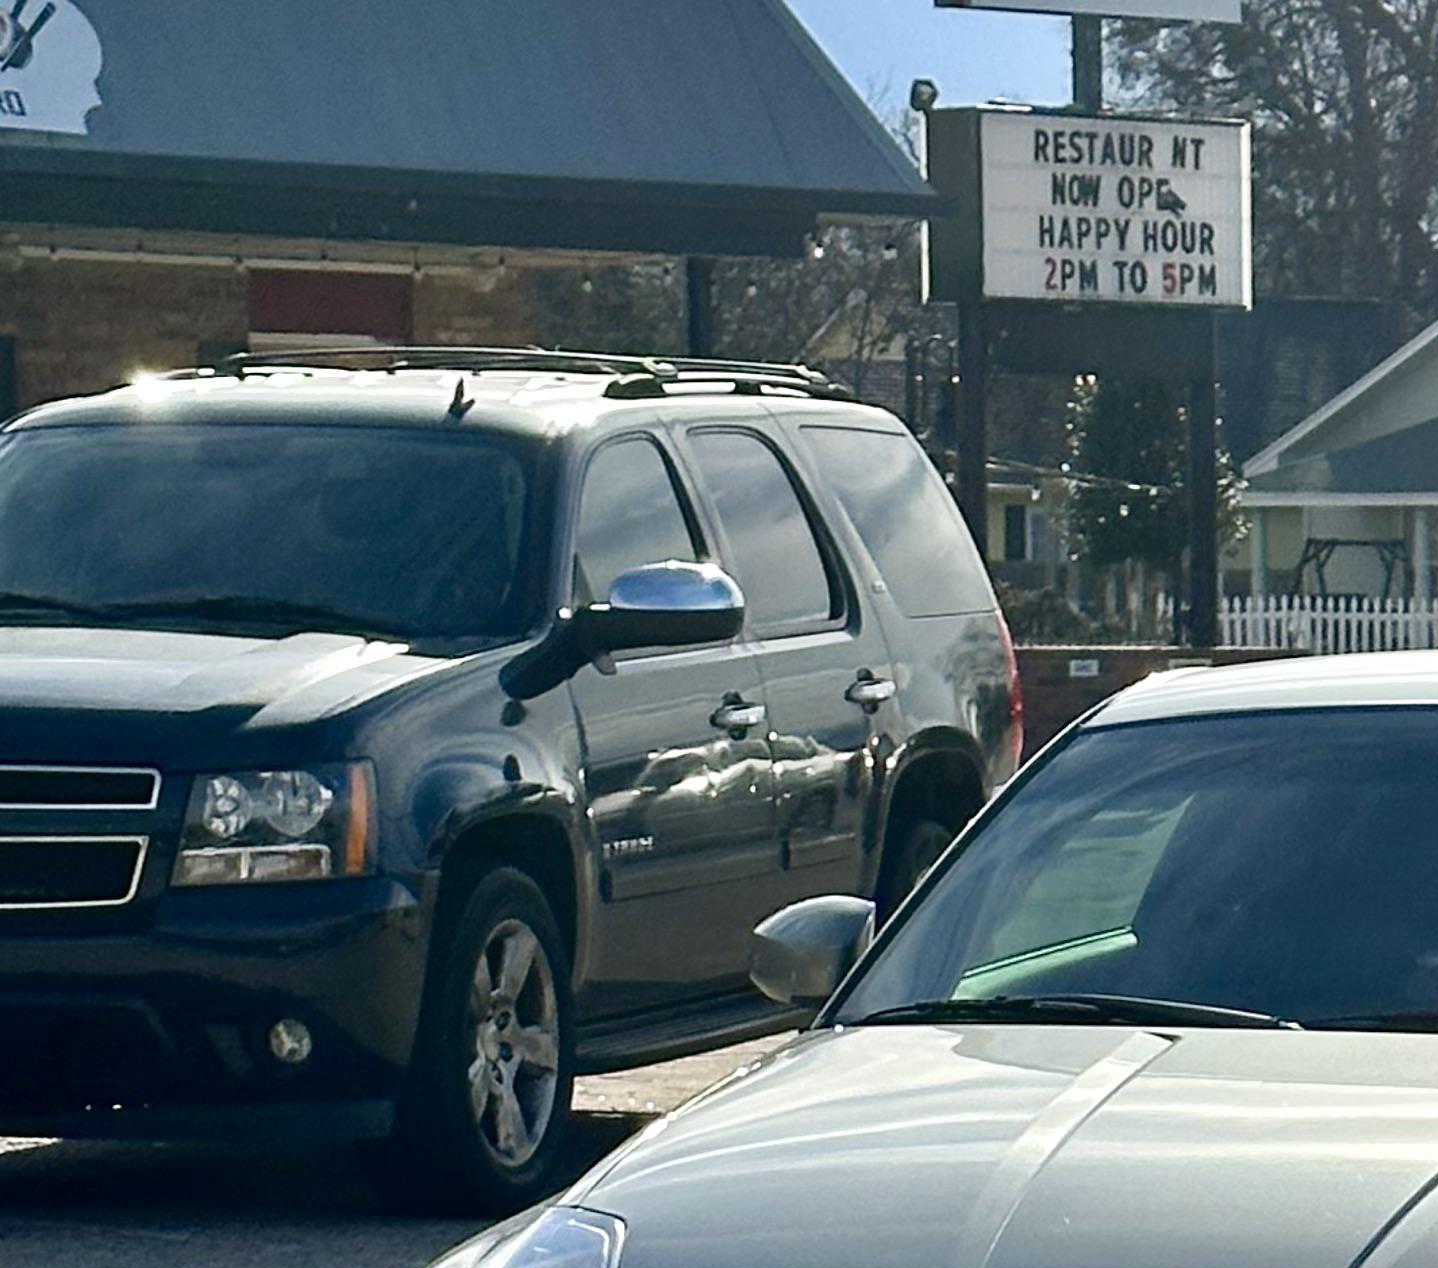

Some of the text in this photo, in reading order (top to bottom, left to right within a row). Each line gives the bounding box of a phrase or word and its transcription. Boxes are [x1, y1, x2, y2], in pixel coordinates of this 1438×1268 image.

[1051, 172, 1102, 207] NOW
[1038, 213, 1216, 255] HAPPY HOUR
[1044, 257, 1217, 296] 2PM TO 5PM
